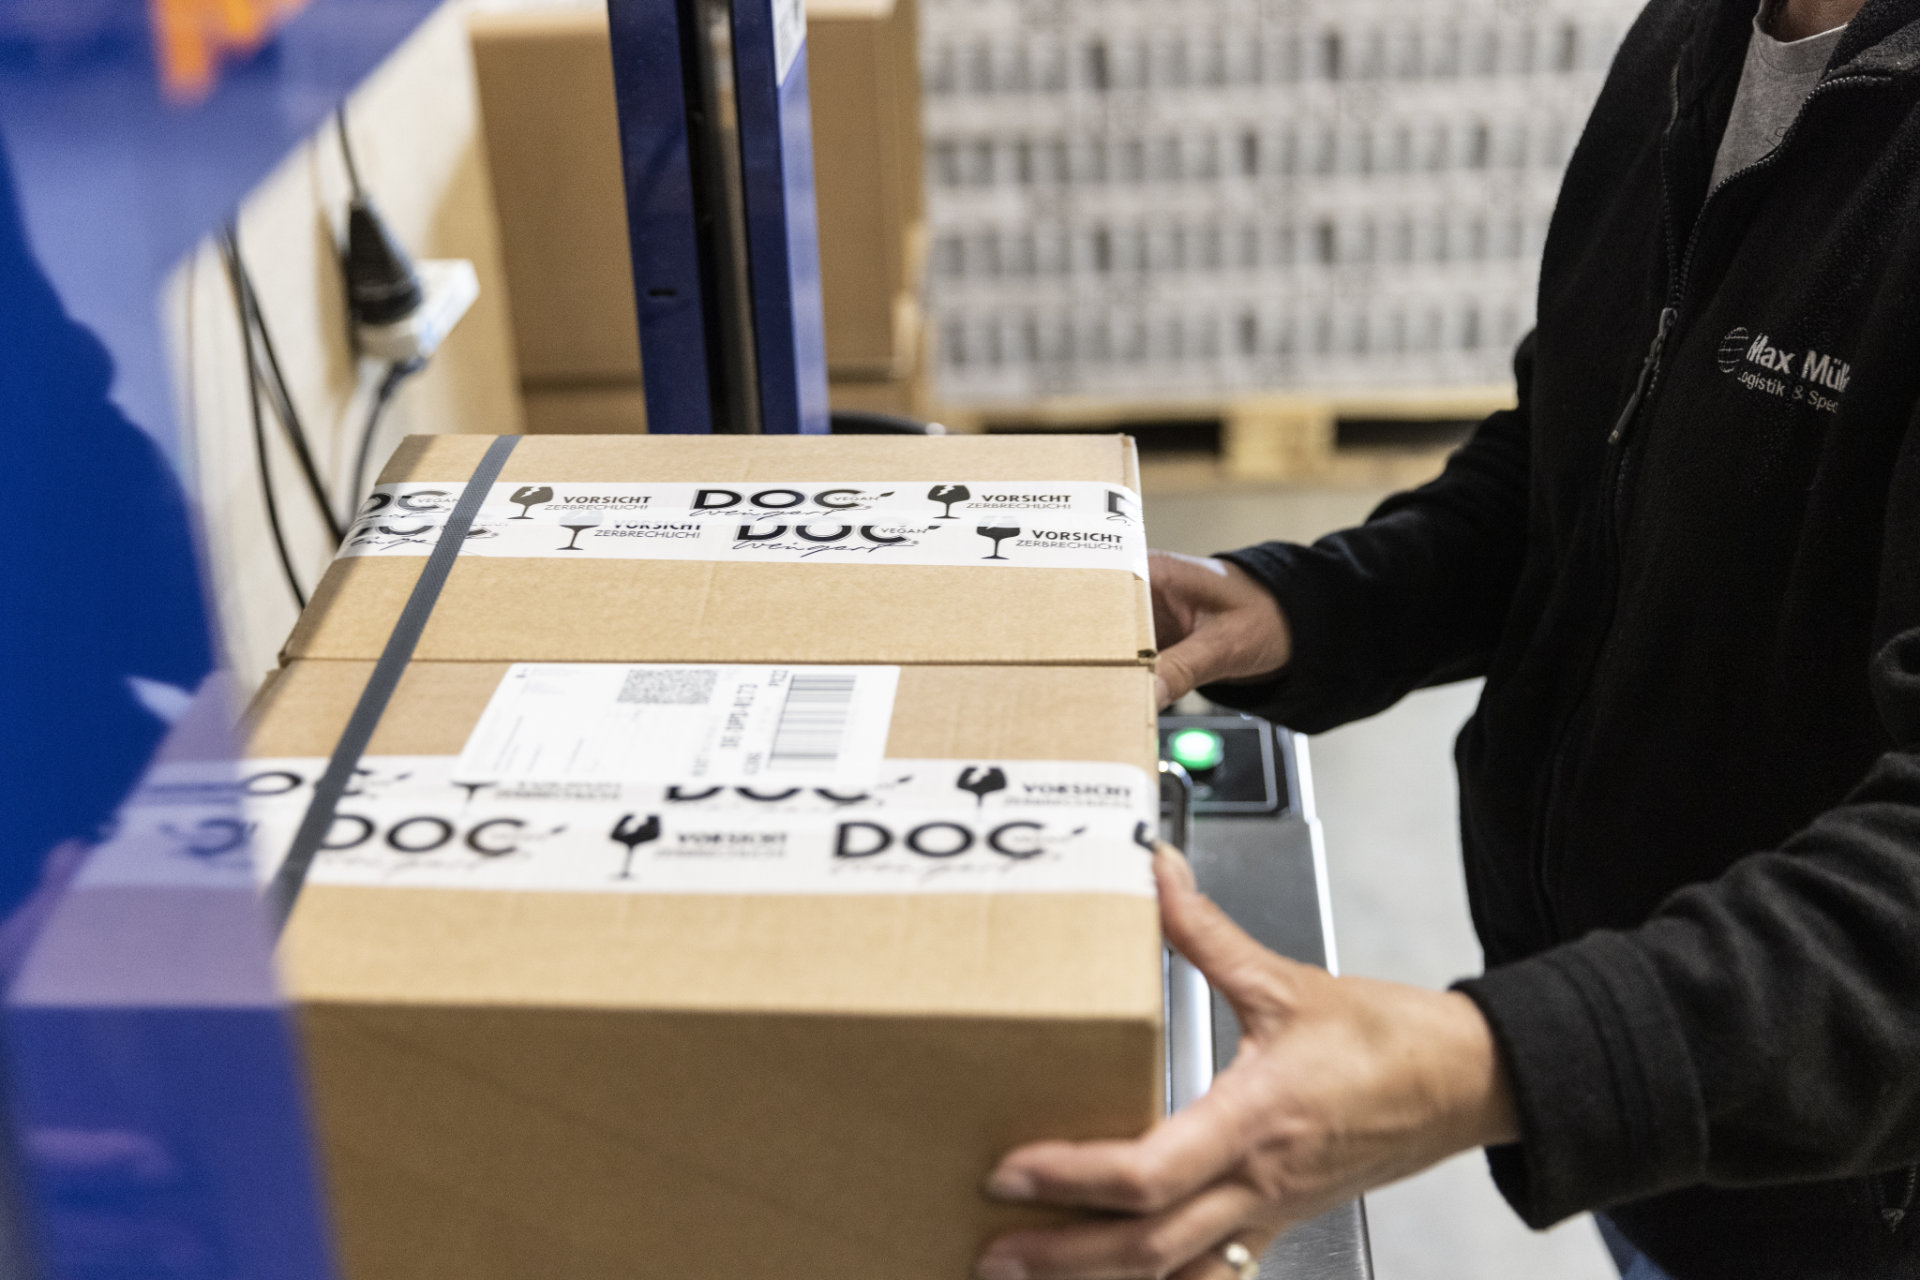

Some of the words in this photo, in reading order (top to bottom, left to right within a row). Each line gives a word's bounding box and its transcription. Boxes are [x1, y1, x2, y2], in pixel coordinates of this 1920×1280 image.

[1746, 333, 1796, 374] Max
[1737, 370, 1786, 396] ogistik
[1792, 385, 1803, 399] &
[563, 496, 652, 504] VORSICHT
[690, 489, 865, 510] DOC
[981, 494, 1072, 503] VORSICHT
[1032, 529, 1123, 543] VORSICHT
[834, 820, 1045, 859] DOC
